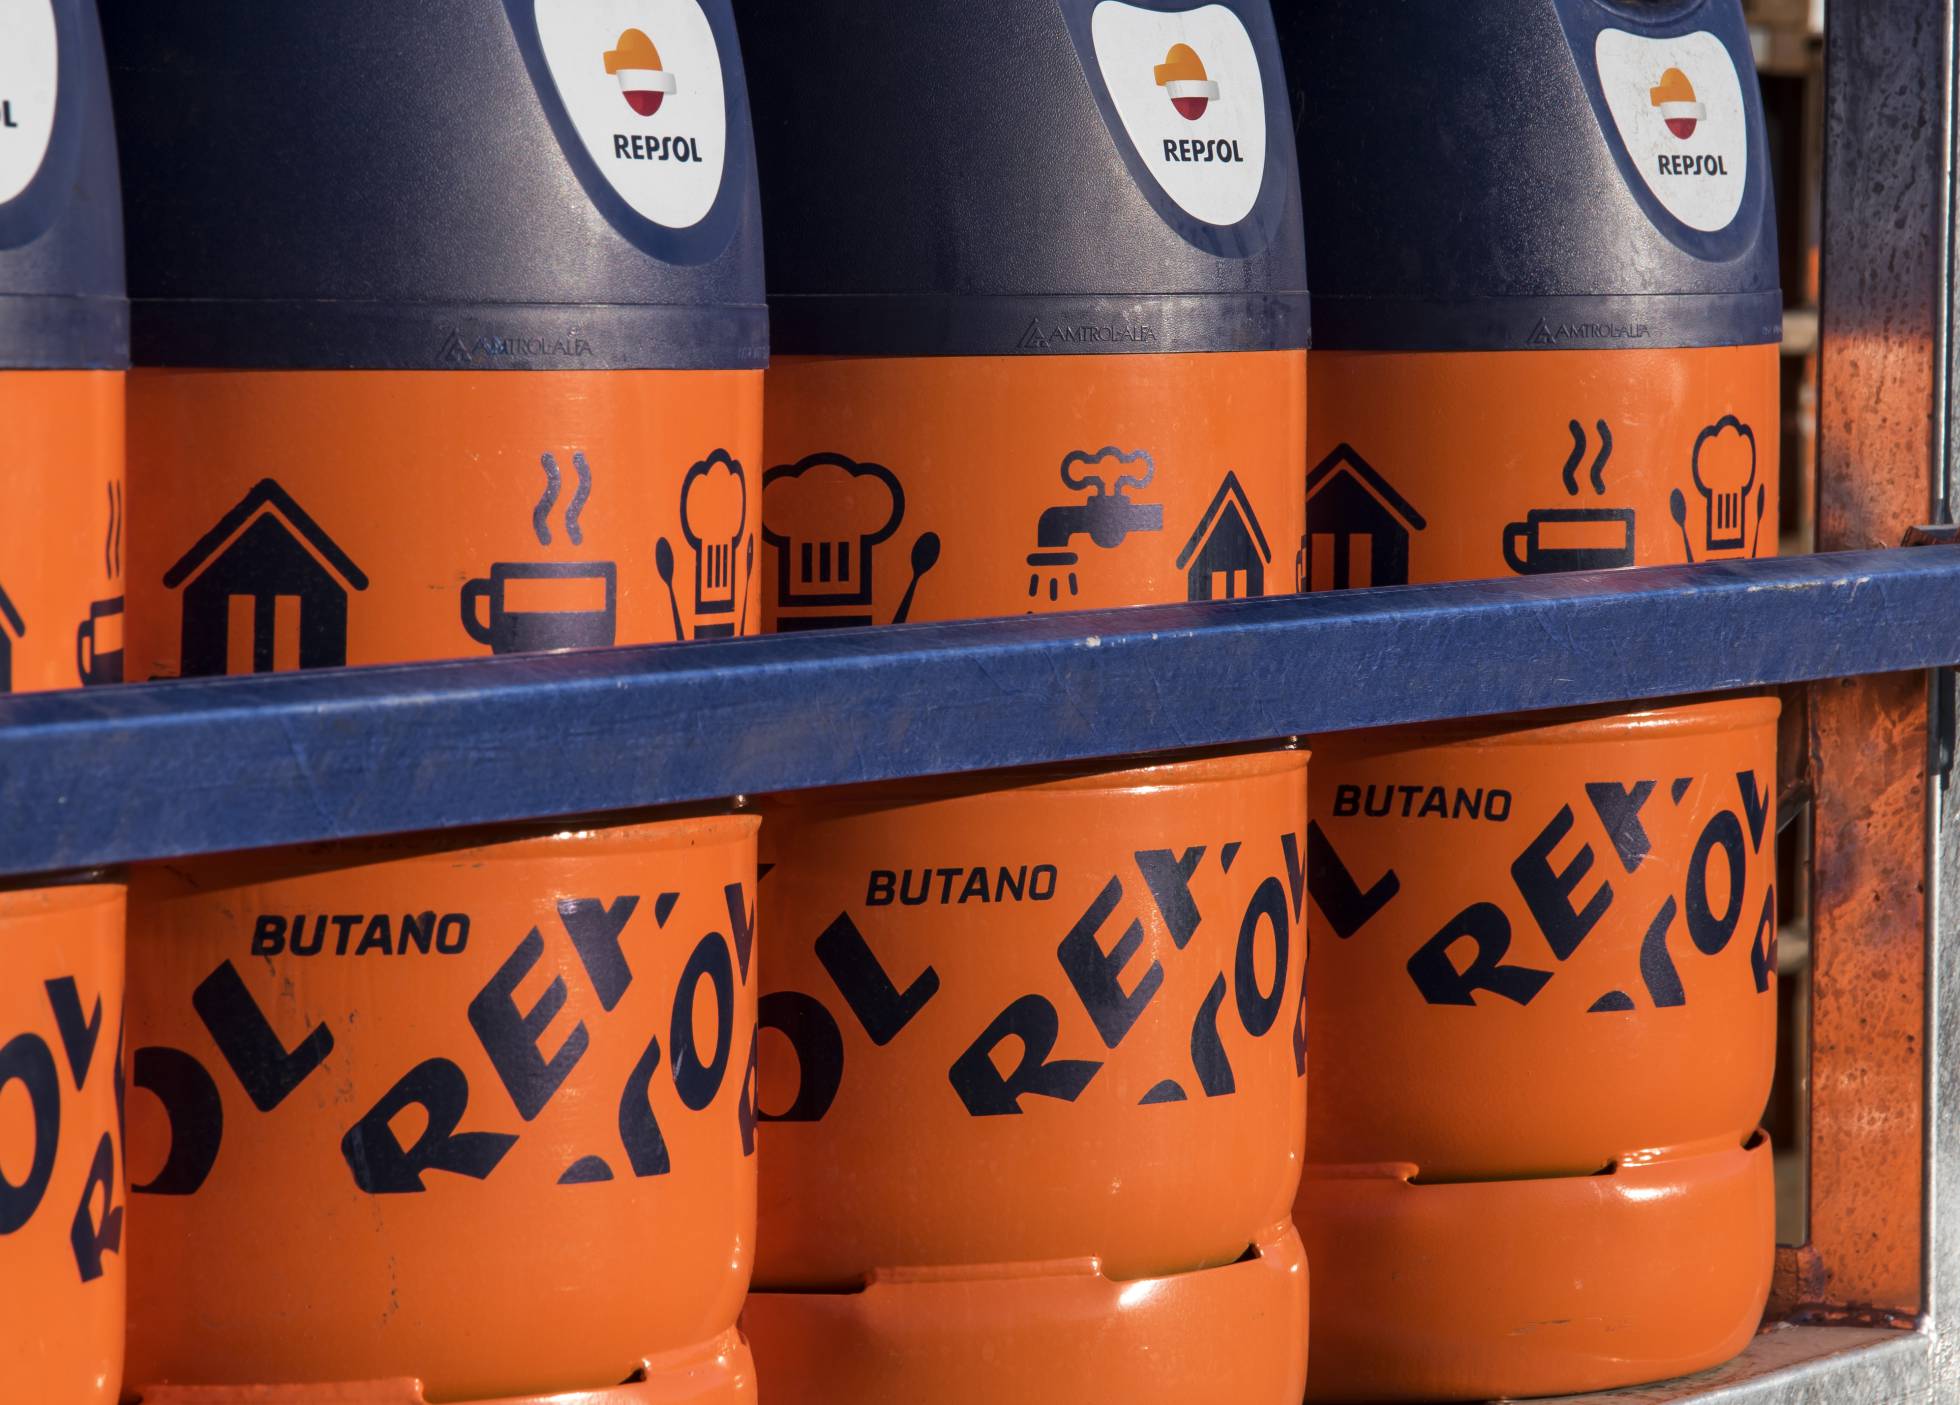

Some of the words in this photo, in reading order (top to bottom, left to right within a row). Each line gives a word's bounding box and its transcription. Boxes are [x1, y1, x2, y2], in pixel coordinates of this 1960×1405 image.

[613, 133, 702, 163] REPSOL
[1163, 139, 1244, 163] REPSOL
[1658, 154, 1728, 176] REPSOL
[1332, 783, 1512, 822] BUTANO
[865, 863, 1057, 906] BUTANO
[251, 911, 471, 956] BUTANO
